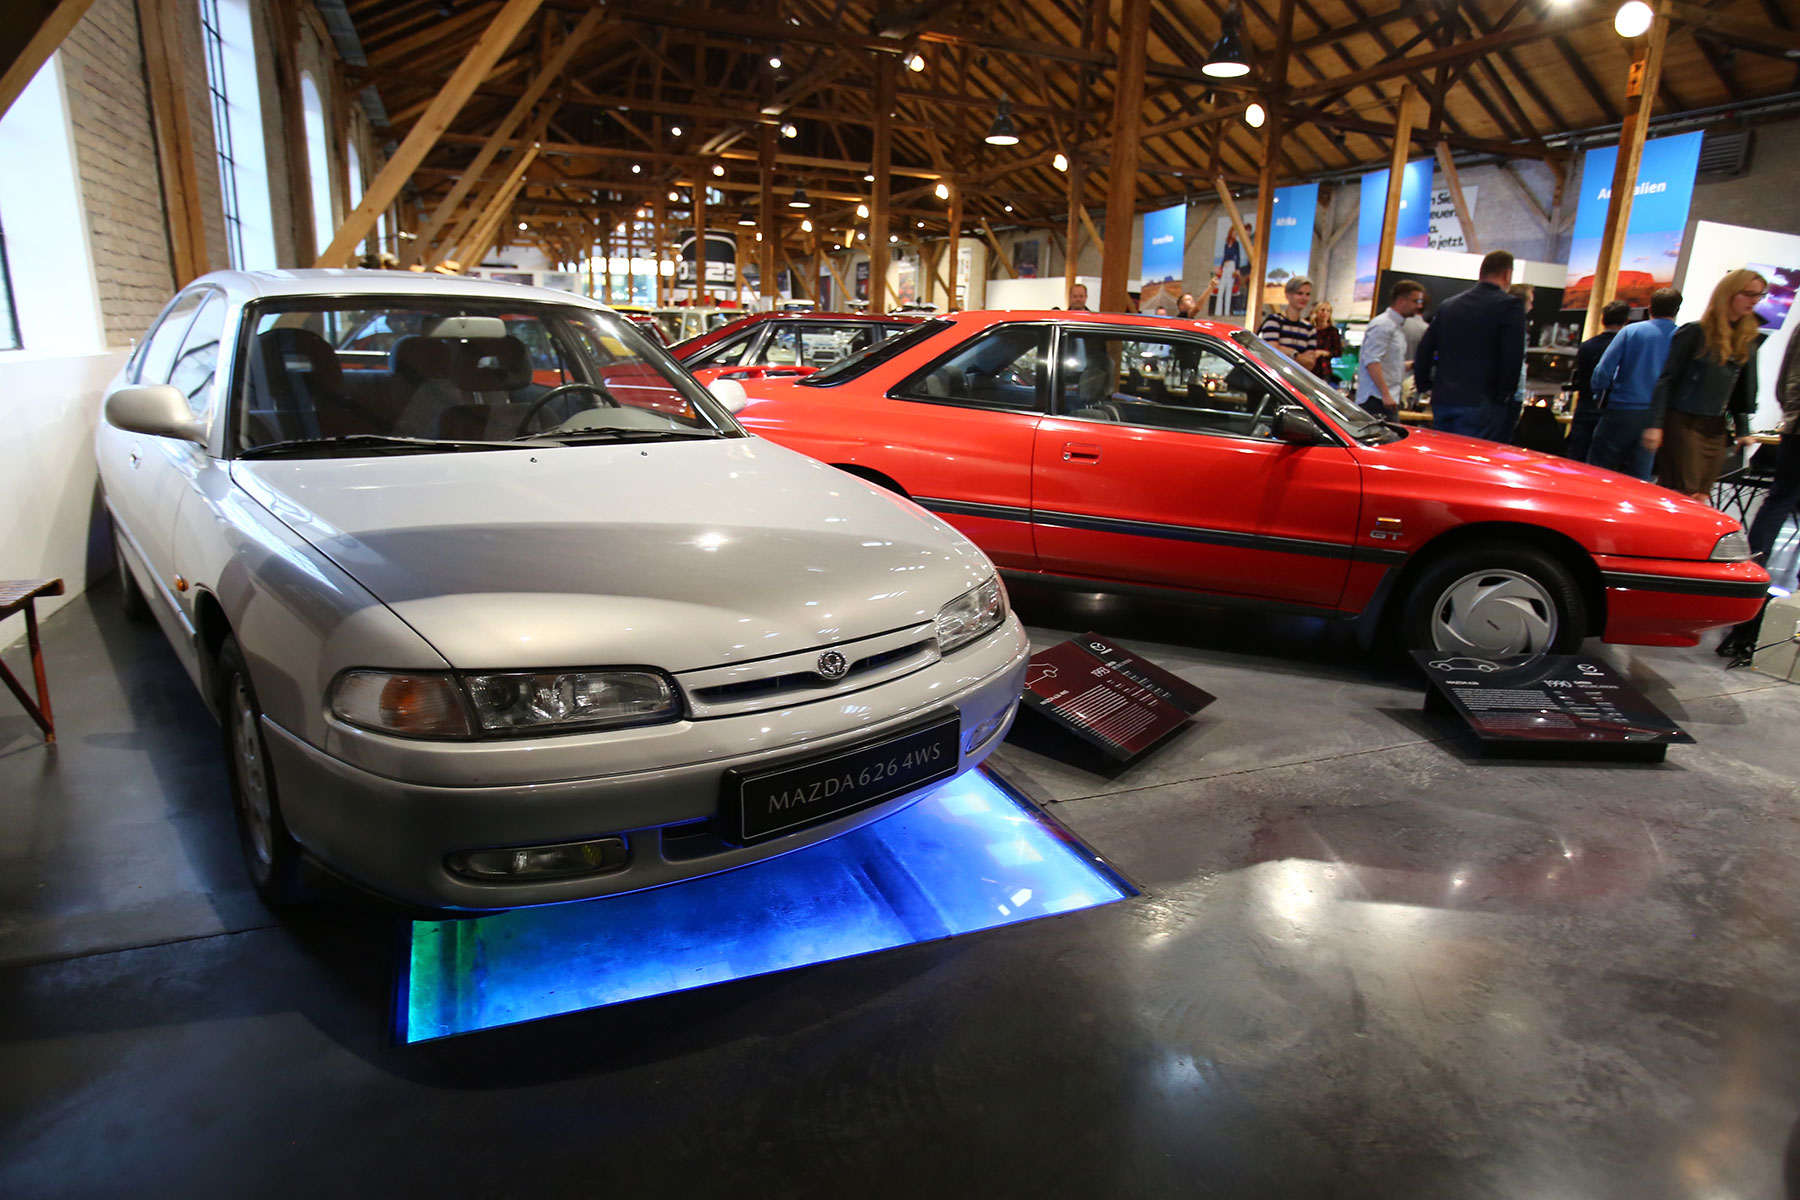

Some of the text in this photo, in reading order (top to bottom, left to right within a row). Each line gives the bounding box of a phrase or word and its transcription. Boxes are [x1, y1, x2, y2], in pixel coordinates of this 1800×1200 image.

[1369, 530, 1404, 541] GT
[768, 742, 941, 814] MAZDA 626 4WS
